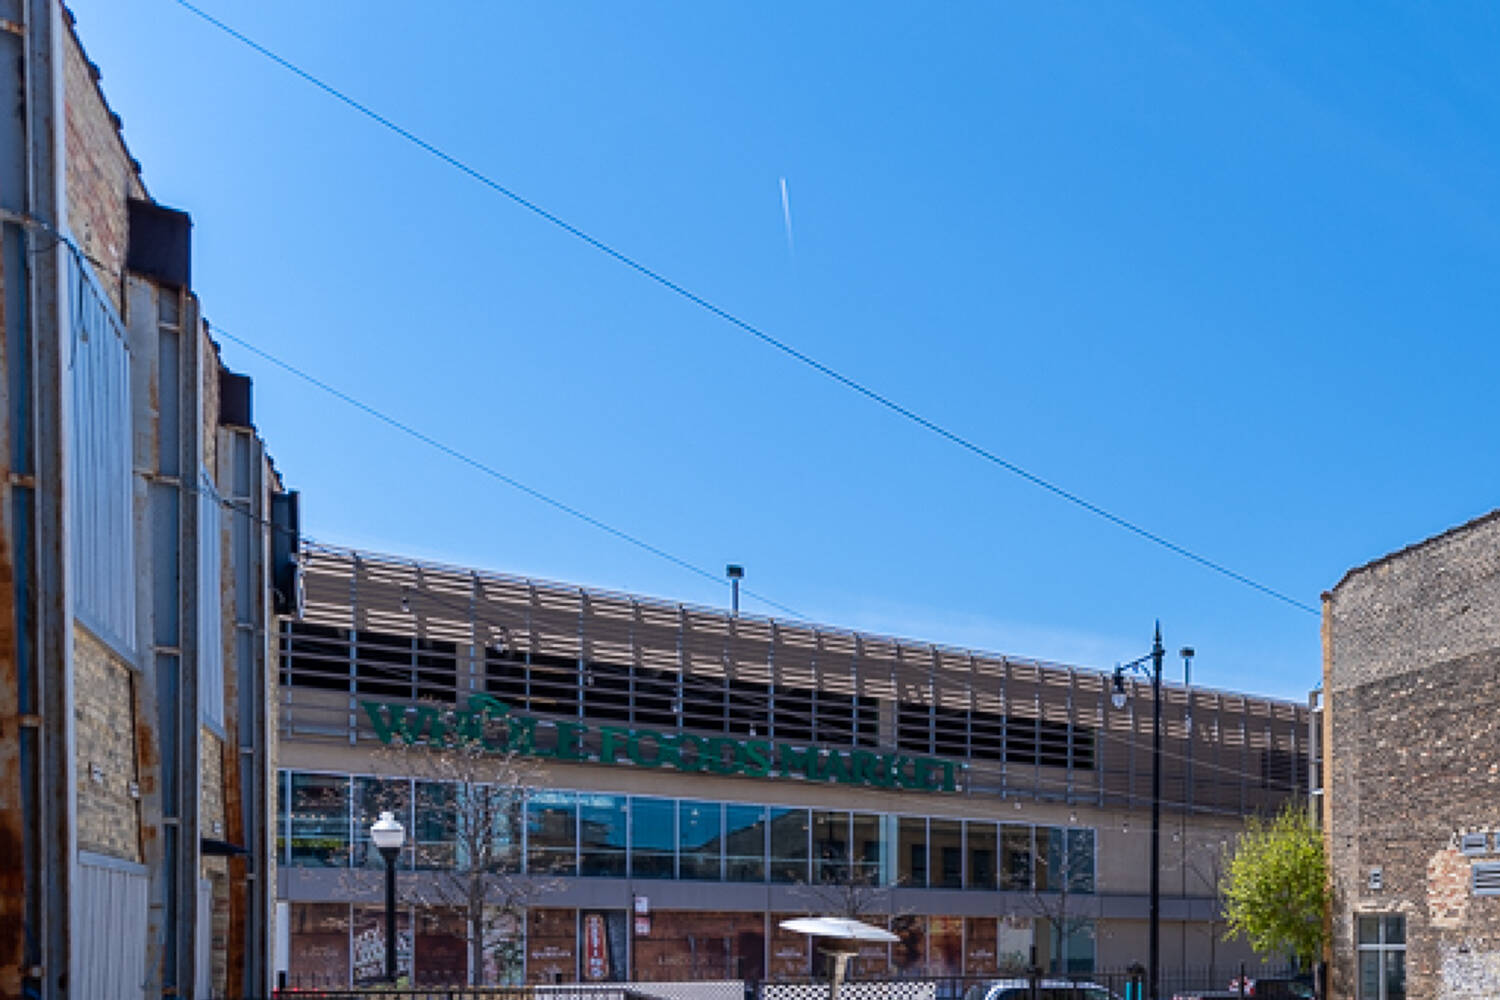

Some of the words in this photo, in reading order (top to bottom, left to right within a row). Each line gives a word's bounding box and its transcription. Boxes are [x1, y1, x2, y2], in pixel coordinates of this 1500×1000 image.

[361, 694, 590, 760] WHOLE
[599, 726, 771, 778] FOODS
[779, 743, 962, 793] MARKET
